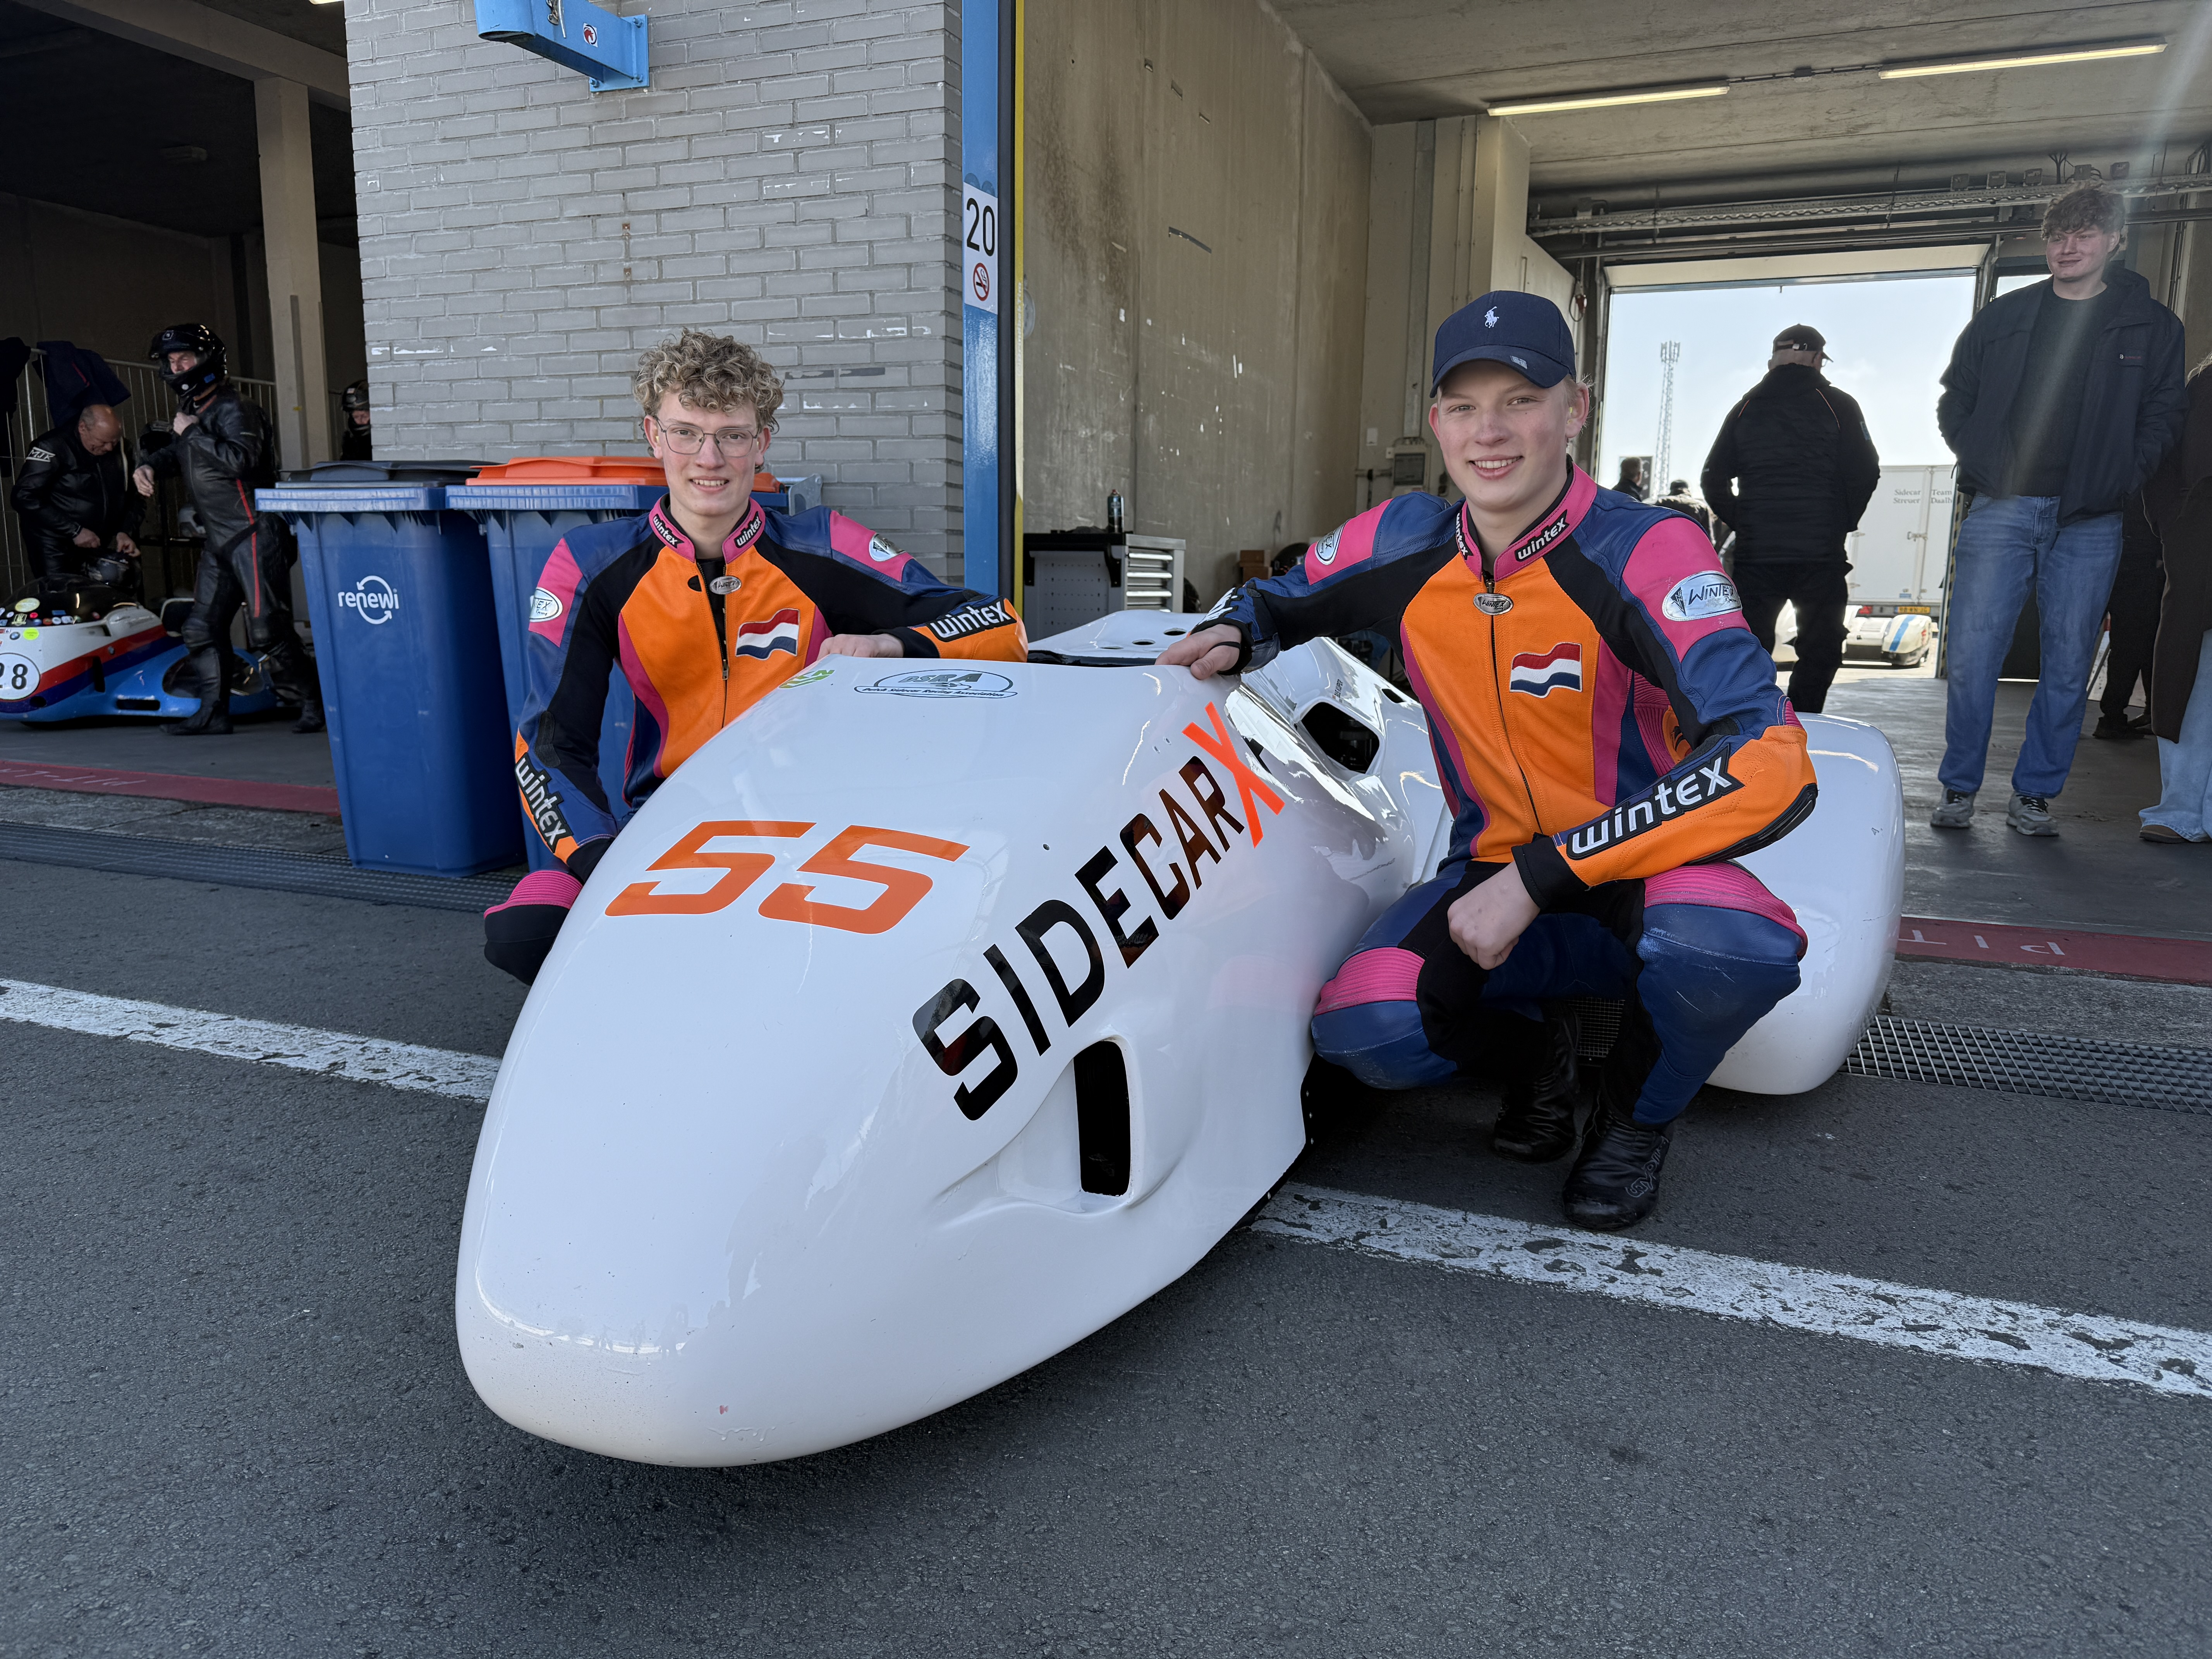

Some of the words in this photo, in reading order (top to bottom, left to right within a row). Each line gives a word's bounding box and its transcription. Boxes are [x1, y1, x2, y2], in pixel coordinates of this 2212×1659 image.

[967, 198, 995, 256] 20
[28, 450, 54, 460] MJK
[1518, 517, 1566, 560] wintex
[930, 601, 1011, 638] wintex
[898, 673, 983, 683] DSRA
[516, 757, 566, 845] wintex
[1572, 756, 1732, 854] wintex
[605, 820, 970, 934] 55
